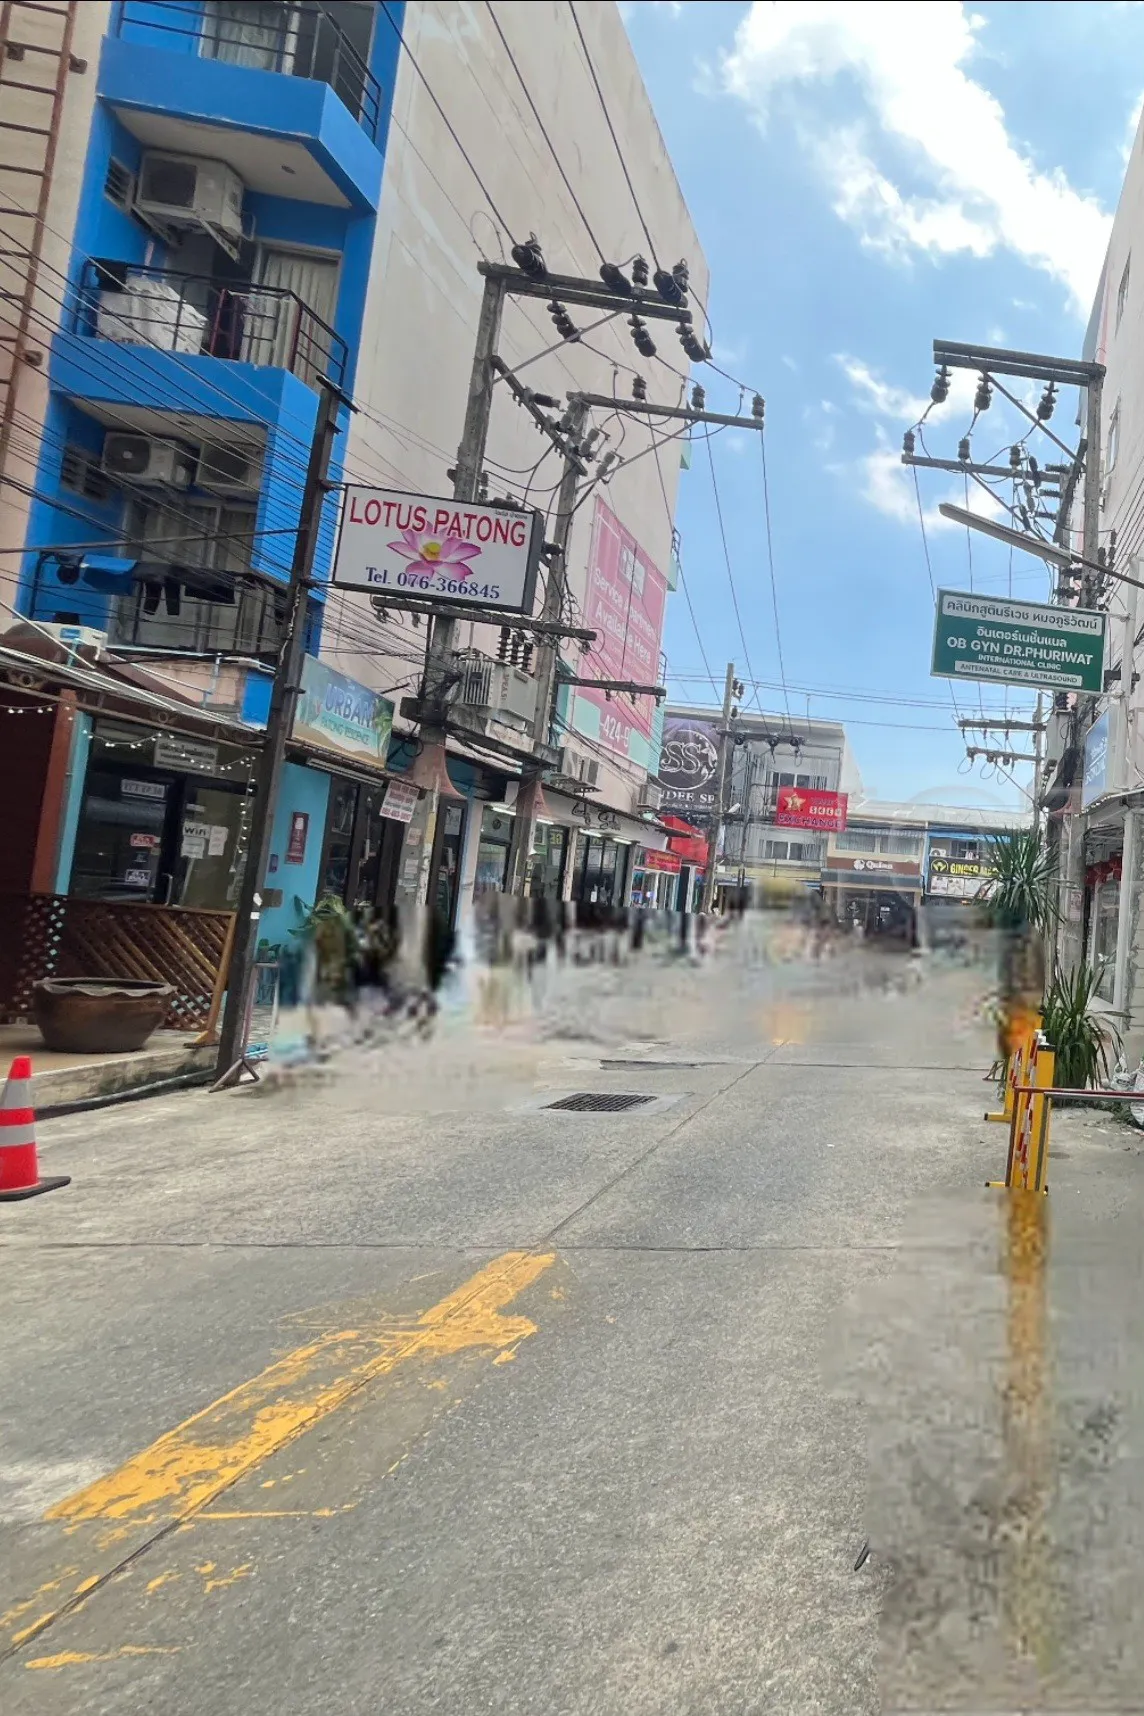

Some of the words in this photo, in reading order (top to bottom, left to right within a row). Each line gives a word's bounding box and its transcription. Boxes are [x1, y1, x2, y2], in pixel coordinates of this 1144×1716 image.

[349, 496, 427, 532] LOTUS
[433, 509, 526, 547] PATONG
[365, 566, 391, 585] Tel.
[396, 572, 501, 599] 076-366845
[946, 636, 967, 649] OB
[970, 641, 1000, 654] GYN
[1003, 644, 1094, 665] DR.PHURIWAT
[978, 654, 1035, 668] INTERNATIONAL
[1037, 662, 1062, 671] CLINIC
[960, 663, 1001, 675] ANTENATAL
[1030, 672, 1078, 684] ULTRASOUND
[325, 682, 373, 729] URBAN
